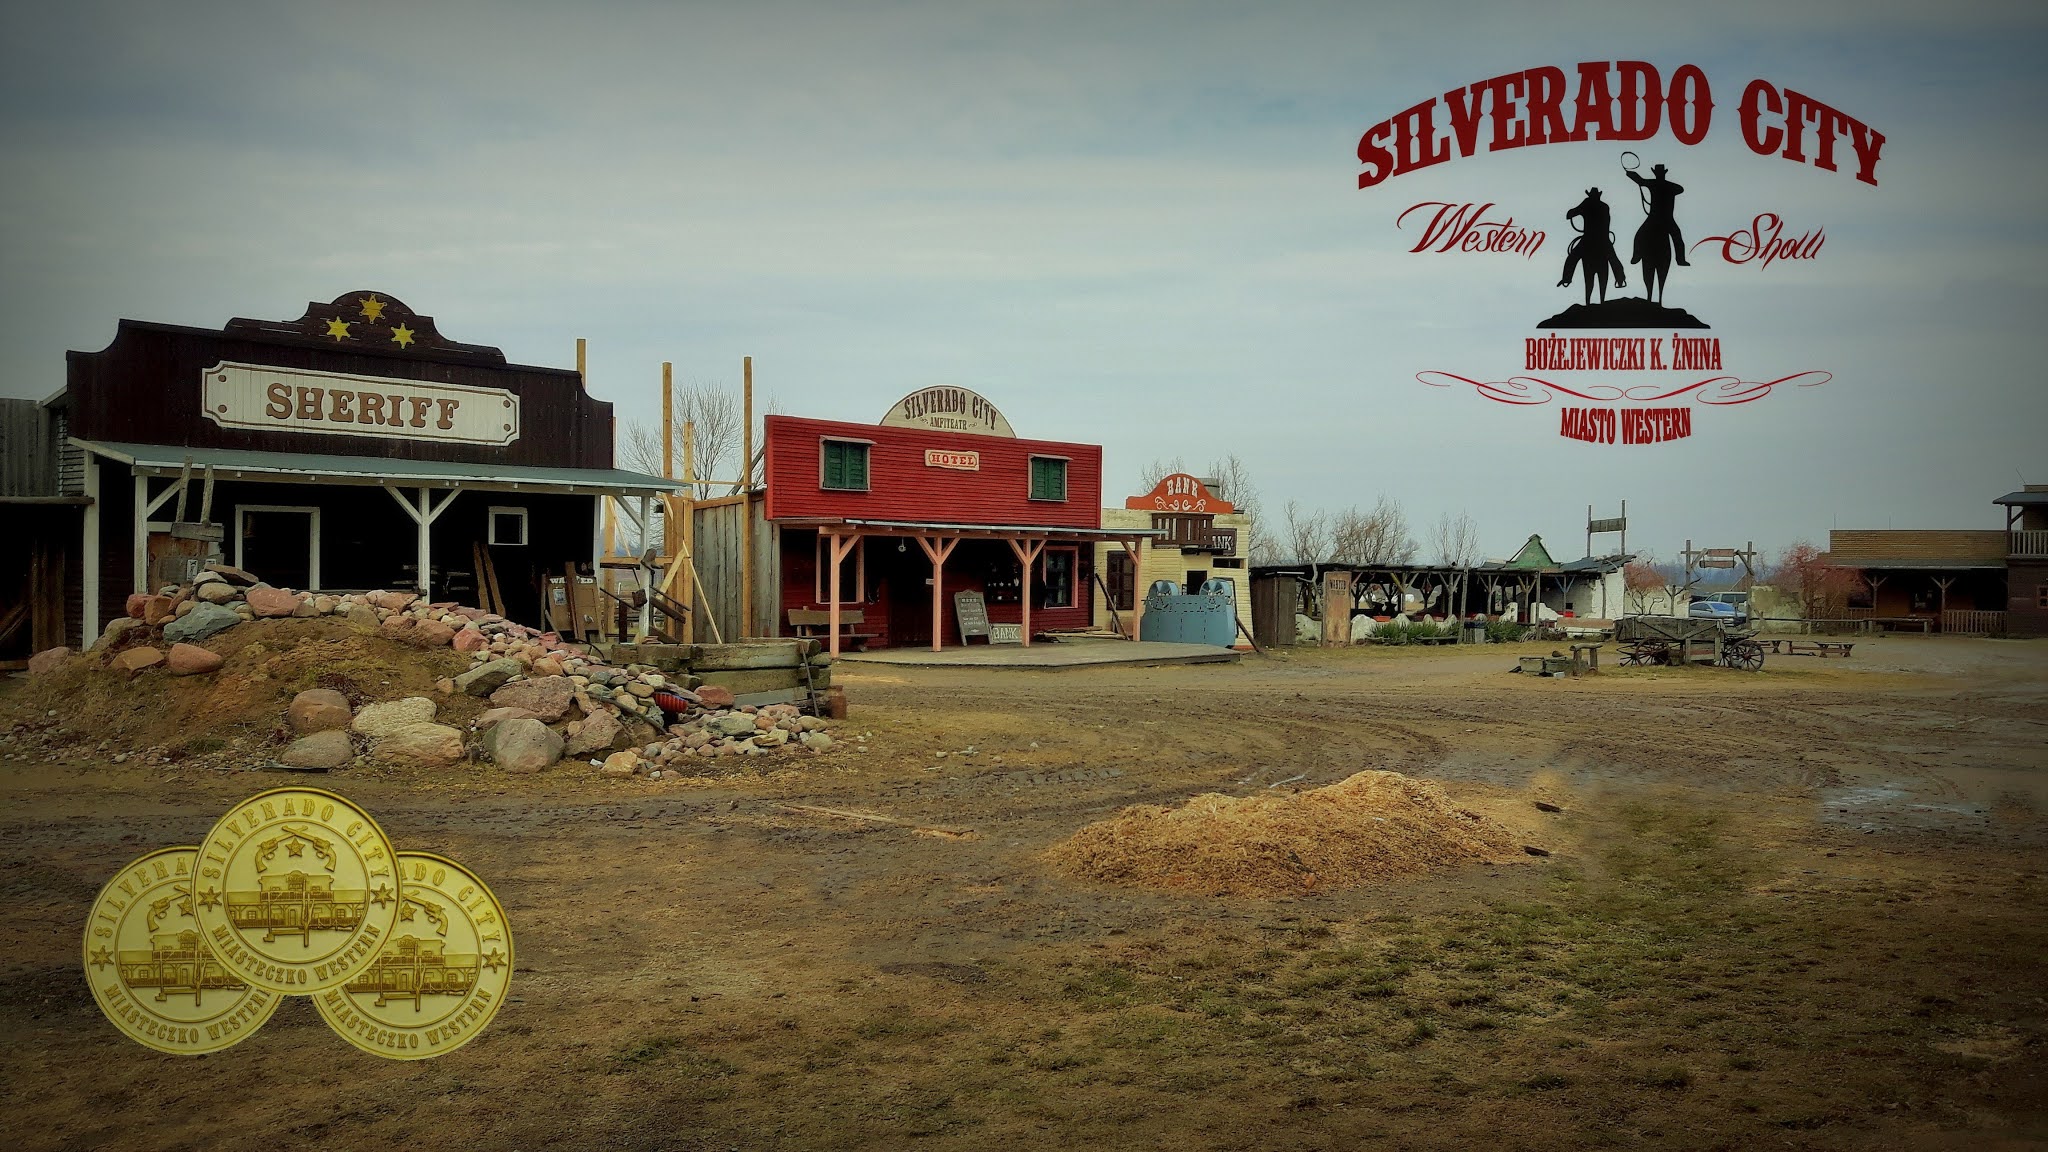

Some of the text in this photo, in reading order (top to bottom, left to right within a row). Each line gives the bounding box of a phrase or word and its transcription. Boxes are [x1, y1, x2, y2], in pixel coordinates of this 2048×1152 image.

[265, 382, 461, 430] SHERIFF
[904, 388, 997, 431] SILVERADO CITY
[929, 415, 968, 431] AMFITEATR
[931, 453, 975, 466] HOTEL
[1166, 476, 1199, 498] BANK
[1211, 535, 1233, 551] ANK
[549, 575, 594, 584] WATED
[992, 626, 1019, 640] BANK
